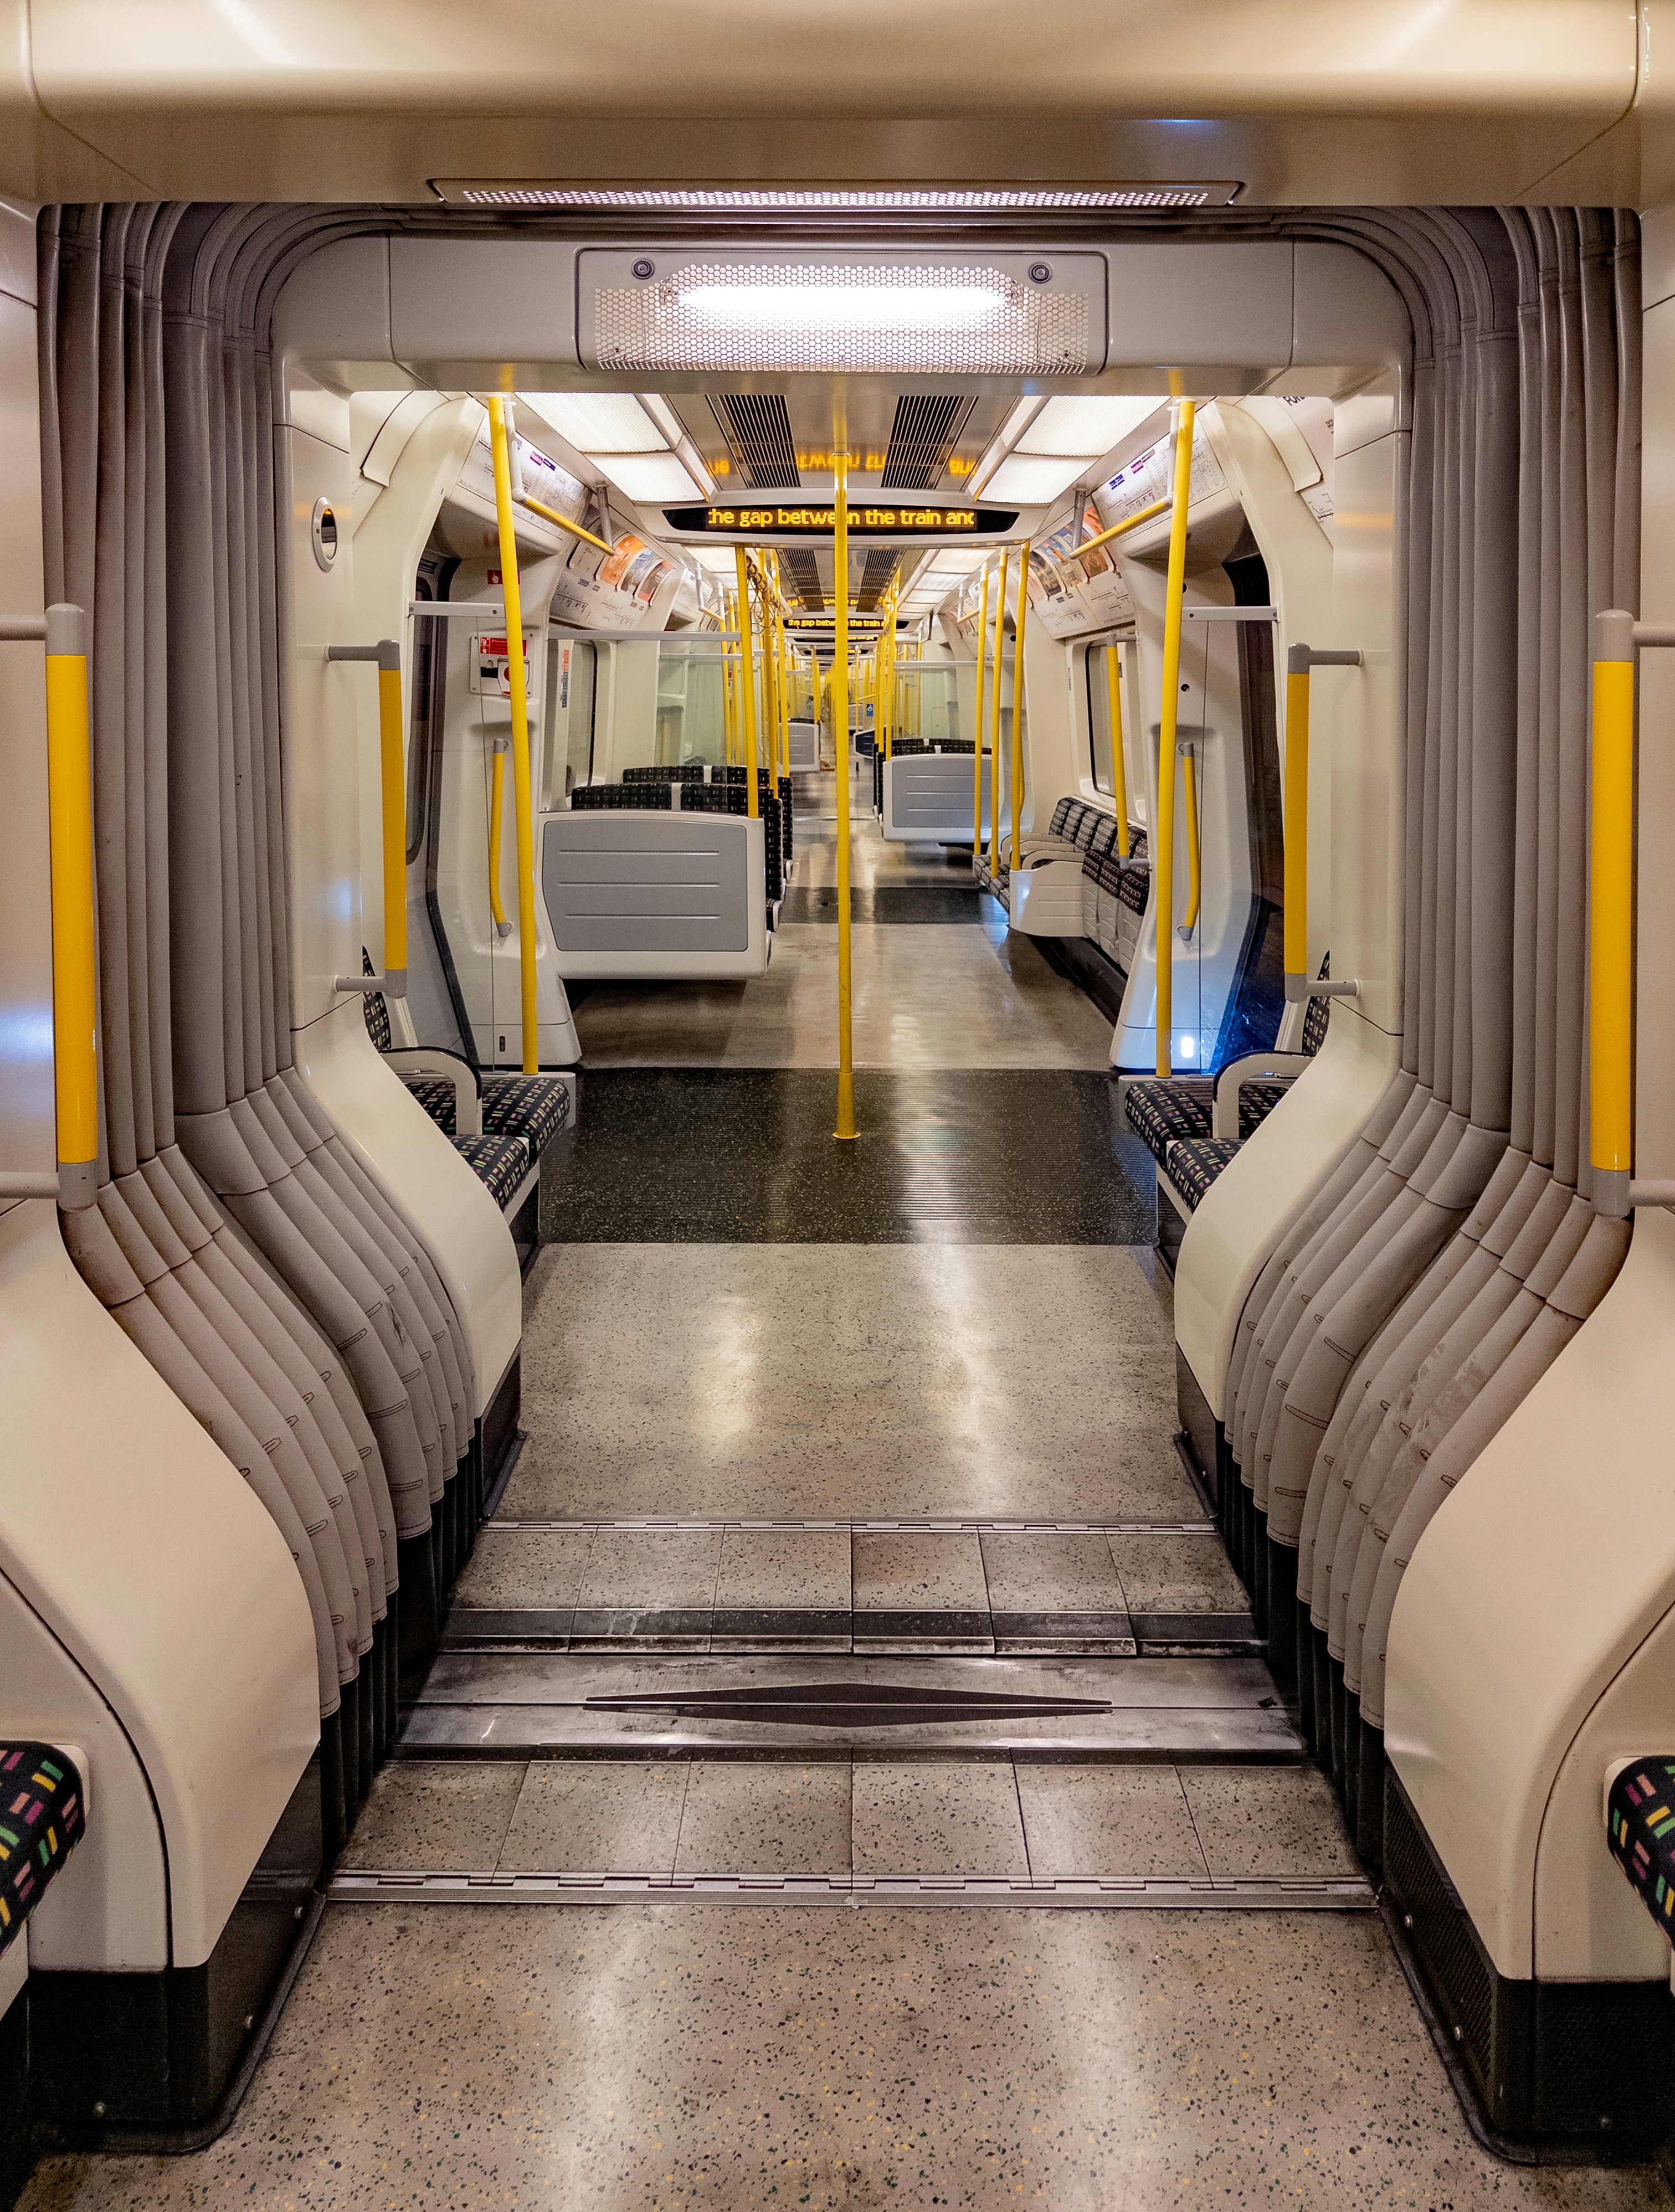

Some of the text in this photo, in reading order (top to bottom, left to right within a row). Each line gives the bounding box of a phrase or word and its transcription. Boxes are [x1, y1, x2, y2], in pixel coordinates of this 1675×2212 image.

[739, 511, 773, 527] gap
[778, 508, 860, 524] betwen
[865, 510, 895, 524] the
[900, 509, 941, 525] train
